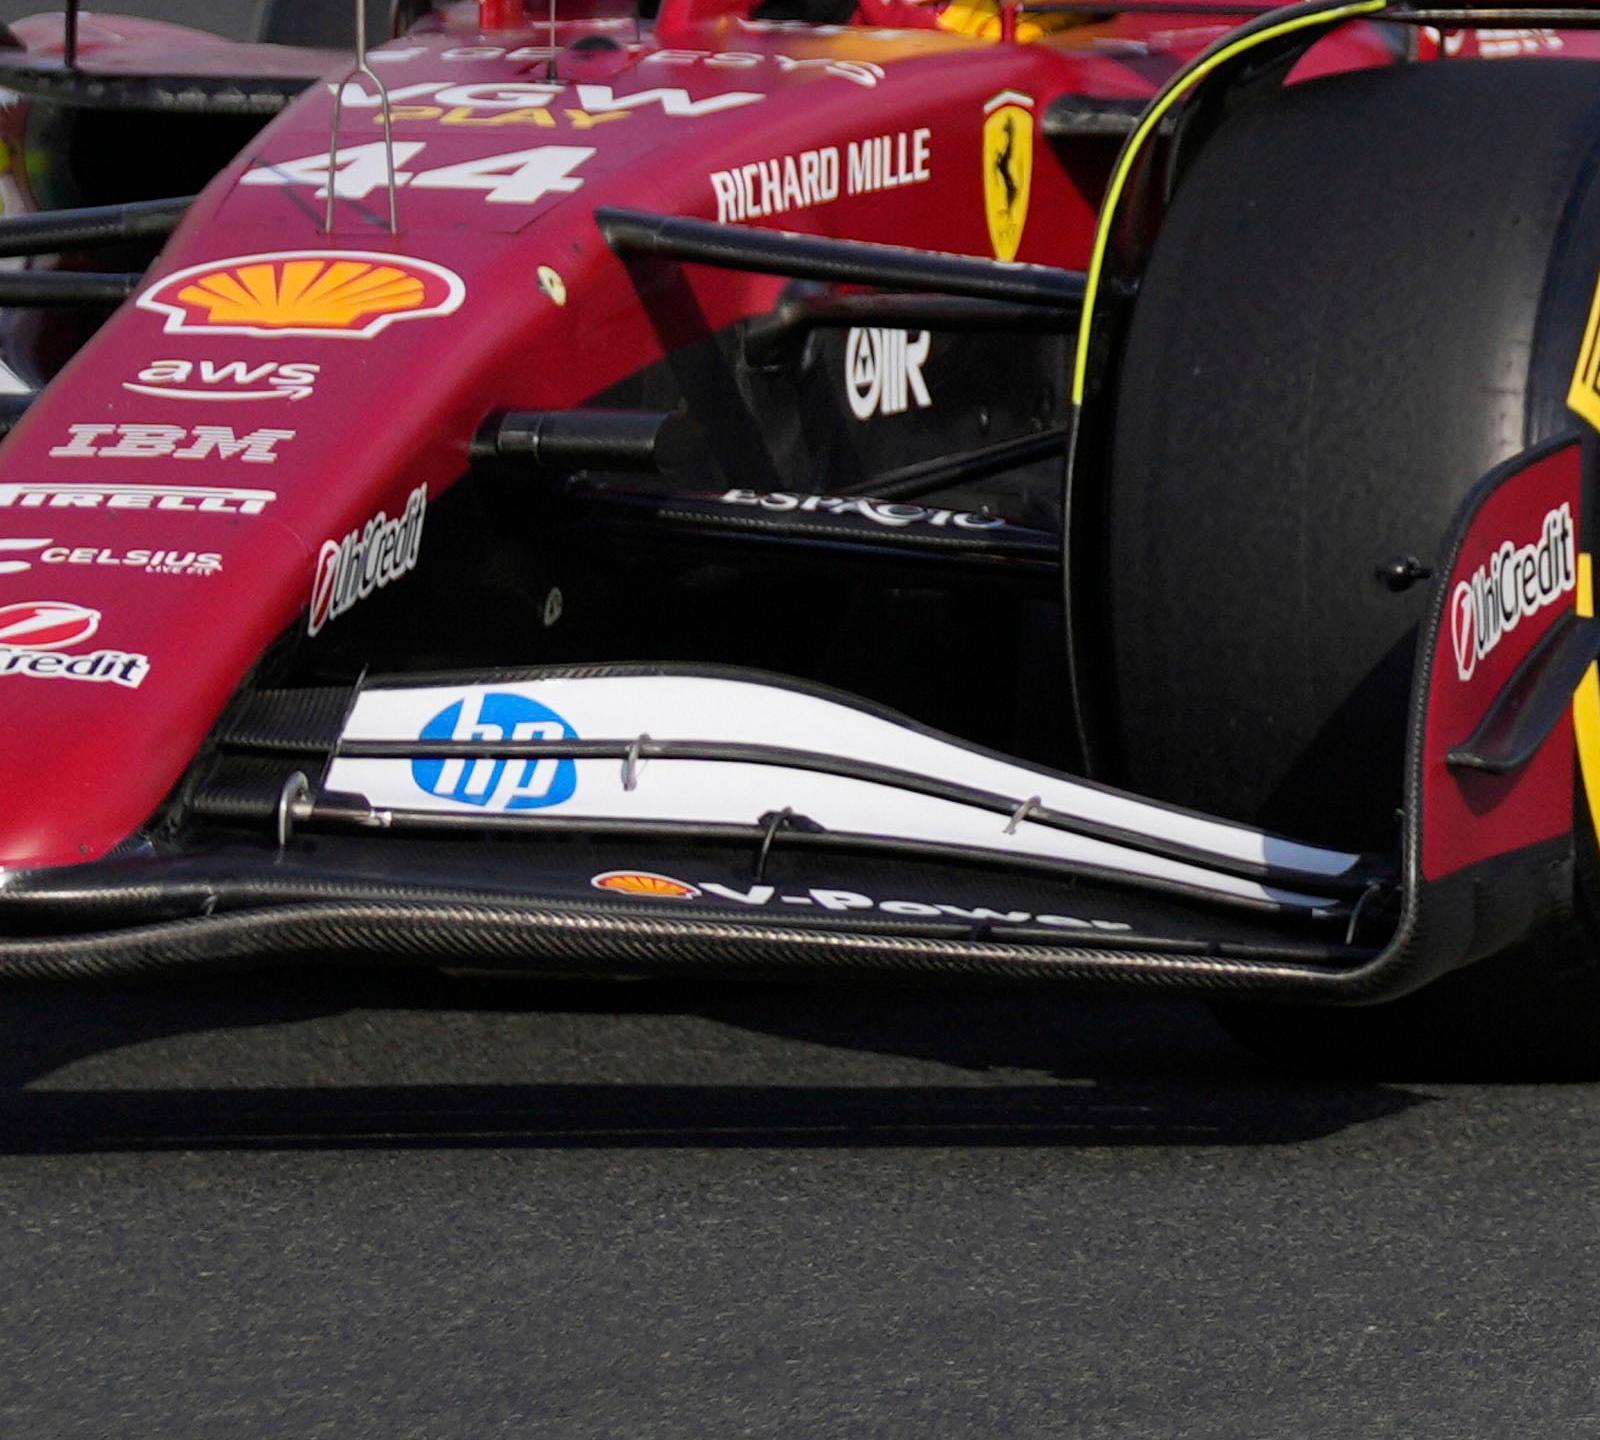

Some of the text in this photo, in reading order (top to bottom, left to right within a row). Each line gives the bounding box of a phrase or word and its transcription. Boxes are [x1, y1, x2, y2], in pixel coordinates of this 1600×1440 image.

[328, 80, 767, 117] VGW
[373, 105, 632, 130] PLAY
[240, 140, 597, 203] 44
[710, 128, 932, 224] RICHARD MILLE
[137, 359, 321, 387] aws
[49, 423, 296, 462] IBM
[40, 547, 224, 568] CELSIUS
[328, 482, 428, 621] UniCredit
[1471, 504, 1576, 660] UniCredit
[431, 692, 568, 810] hp
[699, 882, 1131, 930] V-Power
